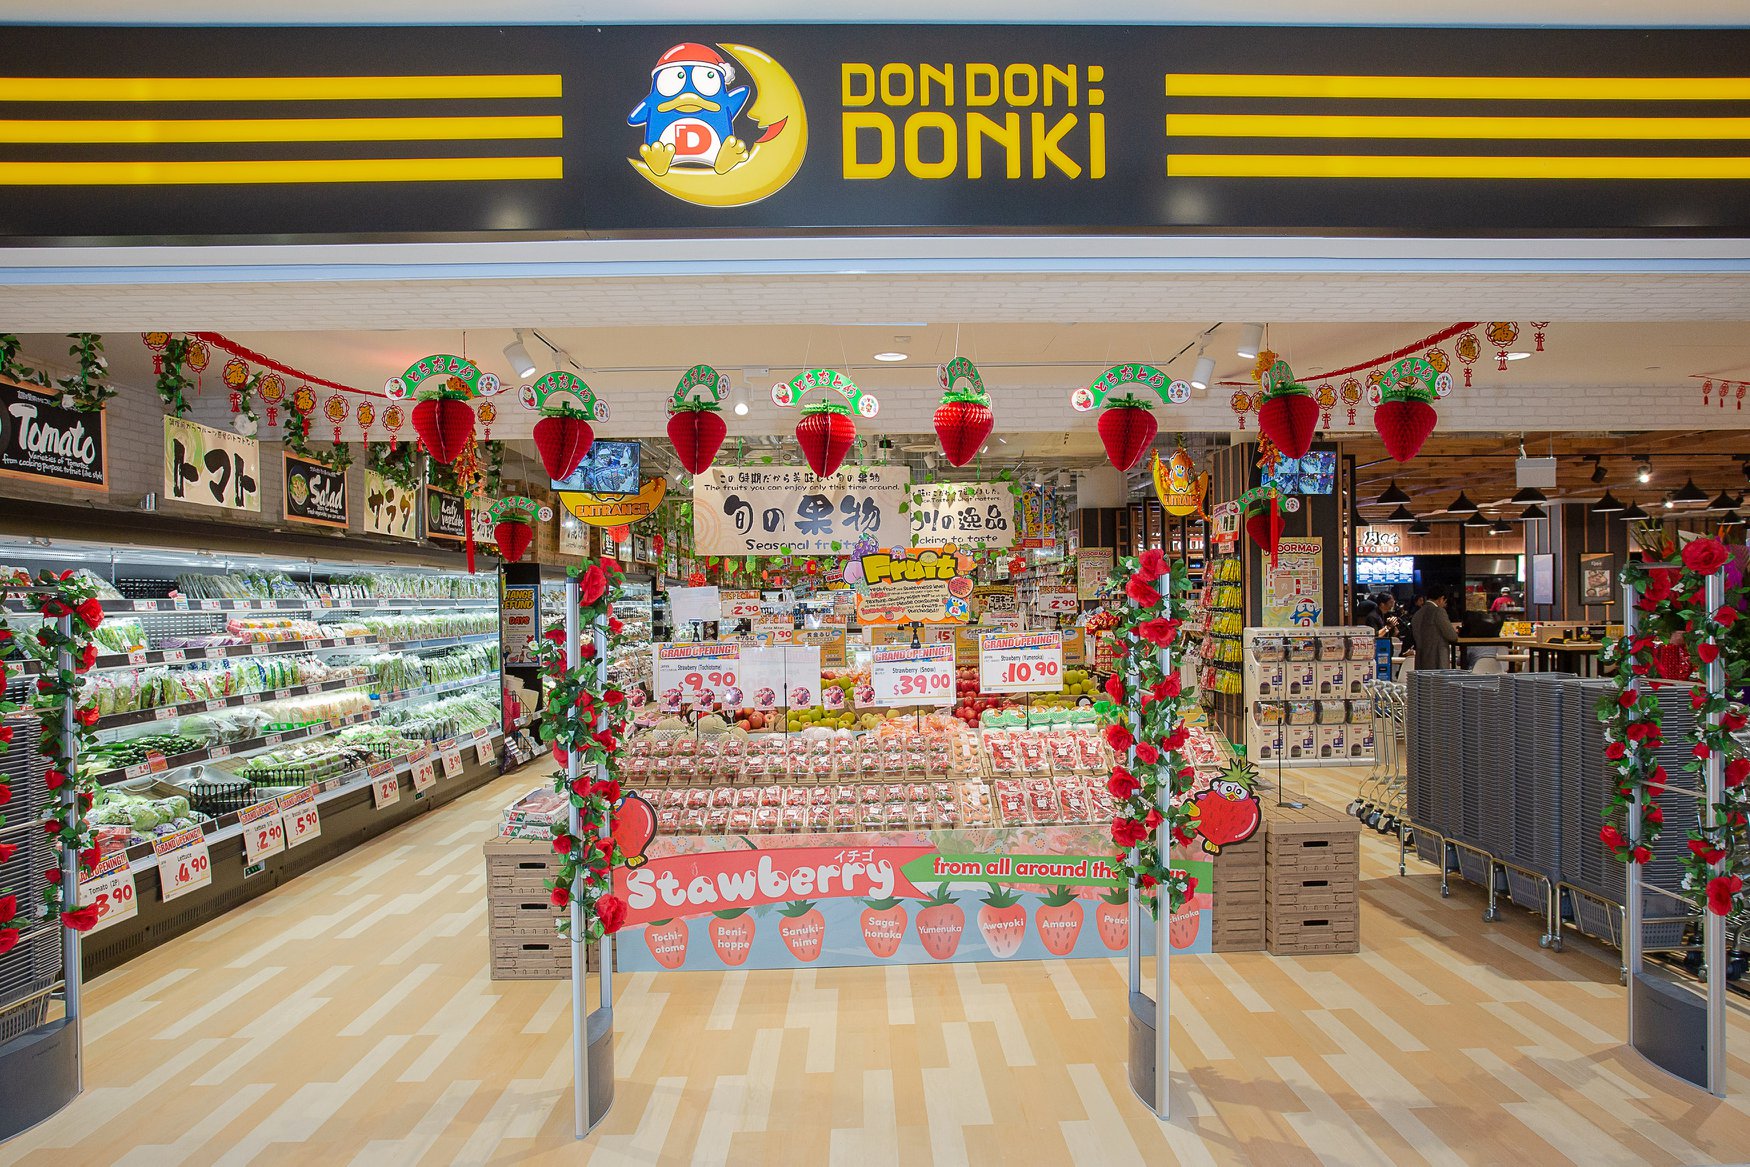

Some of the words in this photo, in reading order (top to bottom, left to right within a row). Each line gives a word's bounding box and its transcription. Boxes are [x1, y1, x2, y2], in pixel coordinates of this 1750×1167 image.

[842, 63, 953, 106] DON
[843, 112, 1106, 179] DONKI
[407, 356, 475, 382] とちおとめ
[1094, 365, 1164, 392] とちおとめ
[1382, 361, 1433, 387] とちおとめ
[538, 373, 591, 402] とちおとめ
[794, 370, 856, 398] とちおとめ
[8, 402, 96, 464] Tomato
[2, 453, 18, 464] from
[19, 458, 42, 471] cooking
[173, 438, 256, 508] トマト
[309, 474, 343, 510] Salad
[784, 484, 807, 492] enjoy
[809, 484, 827, 492] only
[367, 488, 414, 534] サラダ
[575, 502, 650, 517] ENTRANCE
[723, 494, 881, 536] 旬の果物
[917, 536, 948, 545] cking
[967, 534, 998, 544] taste
[861, 549, 958, 585] Fruit
[661, 646, 694, 658] GRAND
[693, 644, 738, 656] OPENING!!
[984, 639, 1013, 649] GRAND
[1014, 635, 1059, 647] OPENING!!
[875, 650, 906, 661] GRAND
[906, 646, 951, 659] OPENING!!
[1002, 662, 1058, 683] $10.90
[893, 674, 951, 695] $39.00
[241, 810, 259, 823] GRAND
[257, 800, 278, 817] OPENING!!
[281, 797, 298, 810] GRAND
[254, 823, 267, 832] Lettuce
[296, 812, 317, 836] $5.90
[156, 840, 176, 855] GRAND
[175, 827, 201, 847] OPENING!!
[256, 825, 282, 852] $2.90
[177, 852, 192, 862] Lettuce
[833, 849, 875, 864] イチゴ
[175, 855, 207, 886] $4.90
[933, 857, 981, 875] from
[985, 857, 1010, 876] all
[1015, 860, 1088, 878] around
[89, 882, 109, 896] Tomato
[109, 879, 121, 889] (2P)
[626, 855, 895, 910] Stawberry
[96, 884, 133, 918] 3.90
[717, 927, 748, 937] Beni-
[782, 926, 825, 938] Sanuki-
[868, 917, 900, 929] Saga-
[982, 918, 1024, 931] Awayoki
[1042, 918, 1078, 928] Amaou
[652, 932, 683, 943] Tochi-
[718, 939, 750, 950] hoppe
[792, 937, 818, 949] hime
[864, 928, 903, 940] honoka
[655, 943, 685, 954] otome
